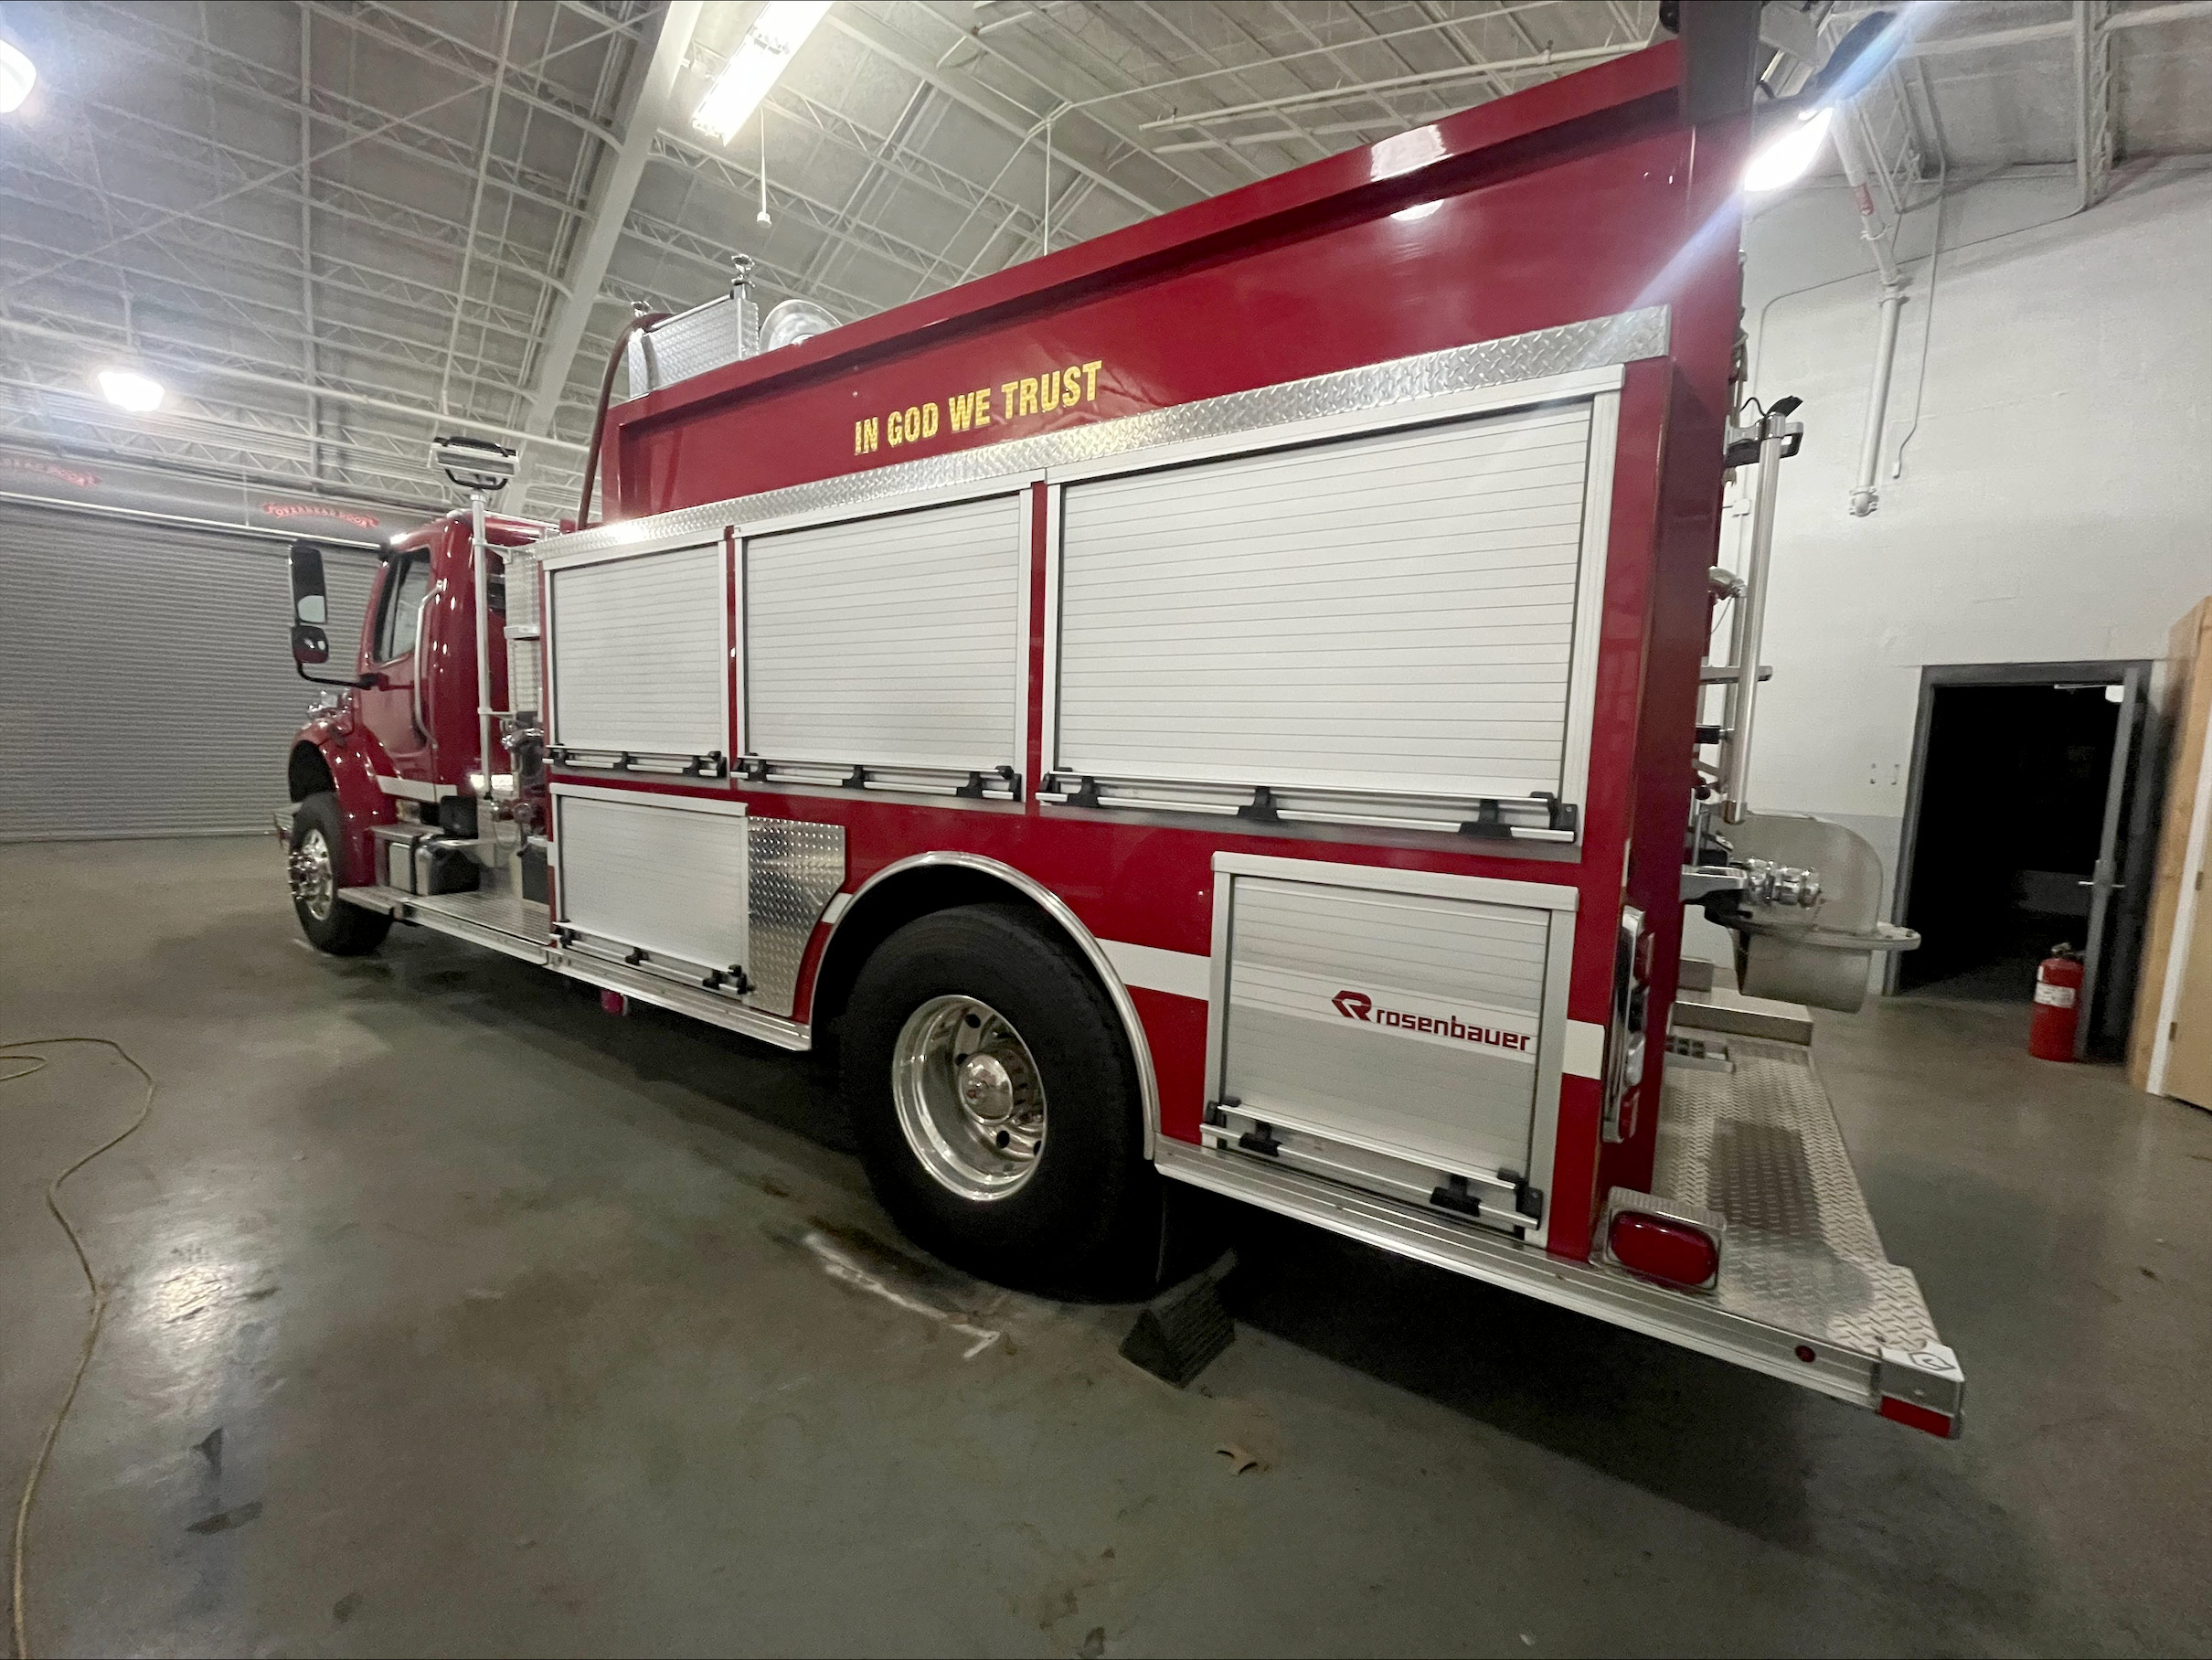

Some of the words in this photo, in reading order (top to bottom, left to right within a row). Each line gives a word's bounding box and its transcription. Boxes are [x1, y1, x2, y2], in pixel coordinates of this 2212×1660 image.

[855, 416, 878, 456] IN
[887, 401, 940, 448] GOD
[948, 387, 992, 433] WE
[1000, 359, 1102, 420] TRUST
[1376, 1008, 1531, 1052] rosenbauer
